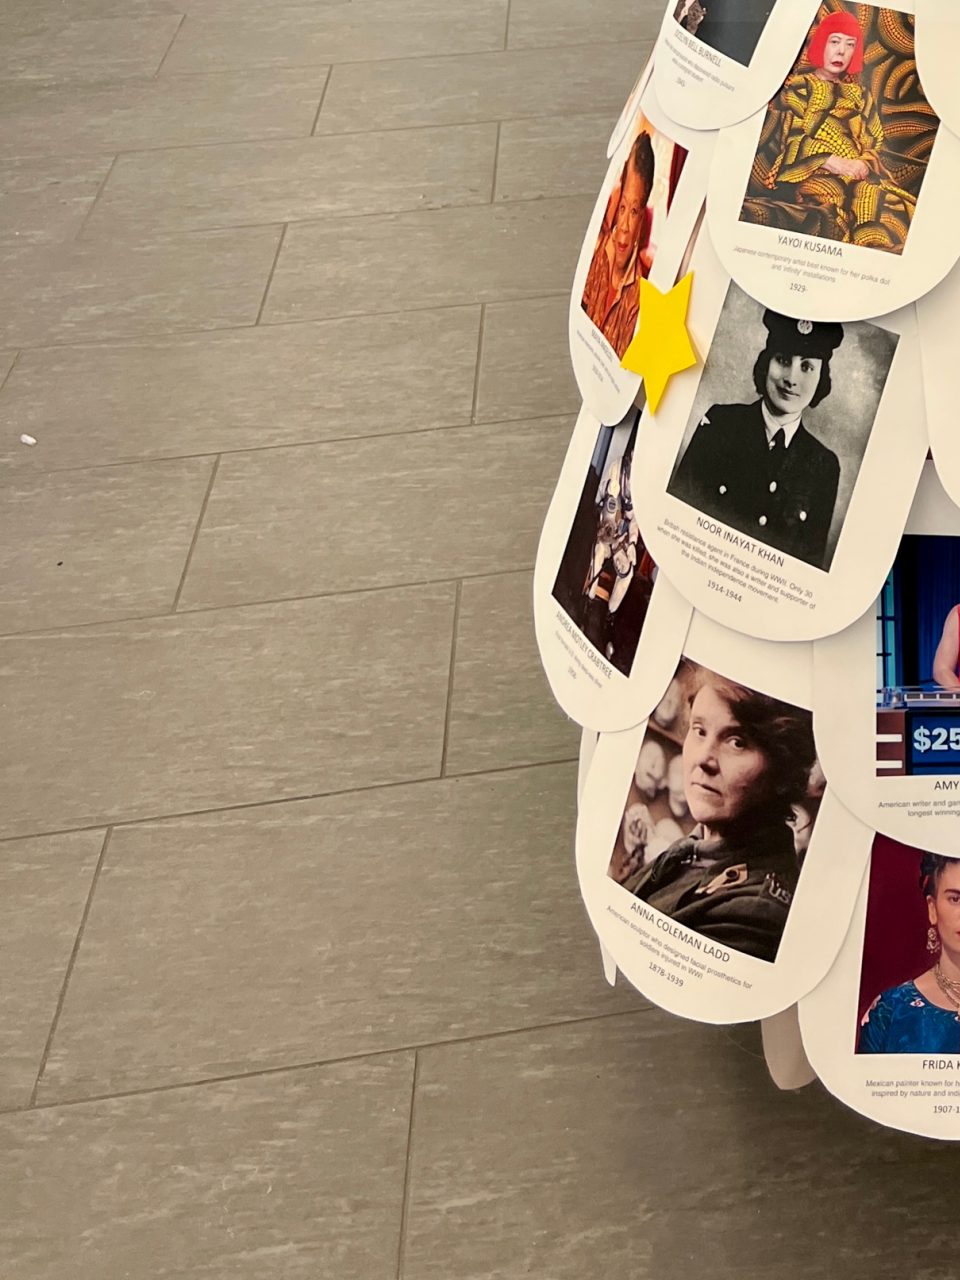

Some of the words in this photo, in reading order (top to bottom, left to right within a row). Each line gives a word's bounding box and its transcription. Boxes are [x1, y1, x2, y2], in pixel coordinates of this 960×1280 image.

[778, 235, 802, 248] YAYOI
[804, 241, 843, 257] KUSAMA
[696, 516, 722, 536] NOOR
[723, 530, 756, 553] INAYAT
[758, 547, 784, 568] KHAN
[707, 579, 742, 603] 1914-1944
[934, 780, 959, 791] AMY
[630, 902, 655, 924] ANNA
[656, 918, 701, 951] COLEMAN
[703, 943, 730, 963] LADD
[648, 961, 684, 987] 1878-1939
[923, 1059, 953, 1070] FRIDA
